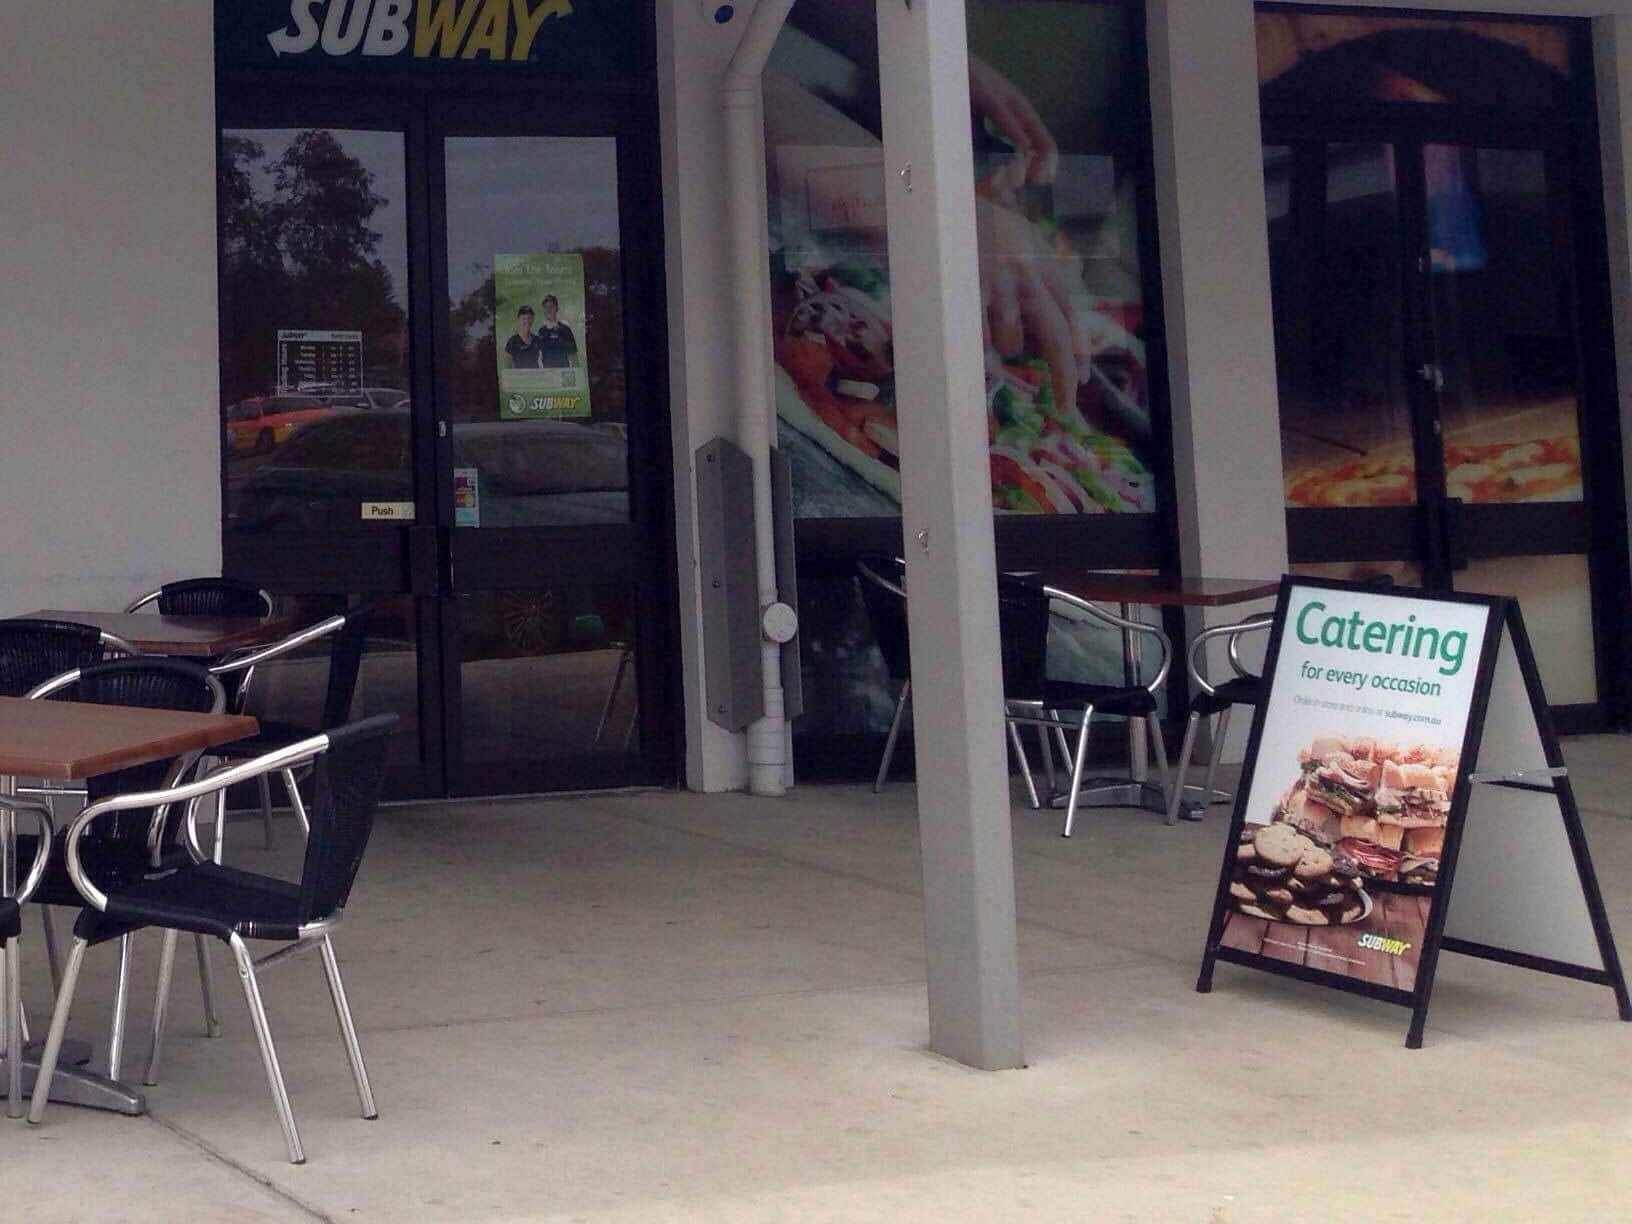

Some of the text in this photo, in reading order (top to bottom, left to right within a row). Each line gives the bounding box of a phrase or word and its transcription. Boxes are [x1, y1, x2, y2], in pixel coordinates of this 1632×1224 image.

[529, 396, 580, 410] SUBWAY
[371, 505, 394, 516] Push
[1296, 601, 1468, 676] Catering
[1301, 660, 1441, 696] for every occasion
[1357, 933, 1412, 956] SUBWAY
